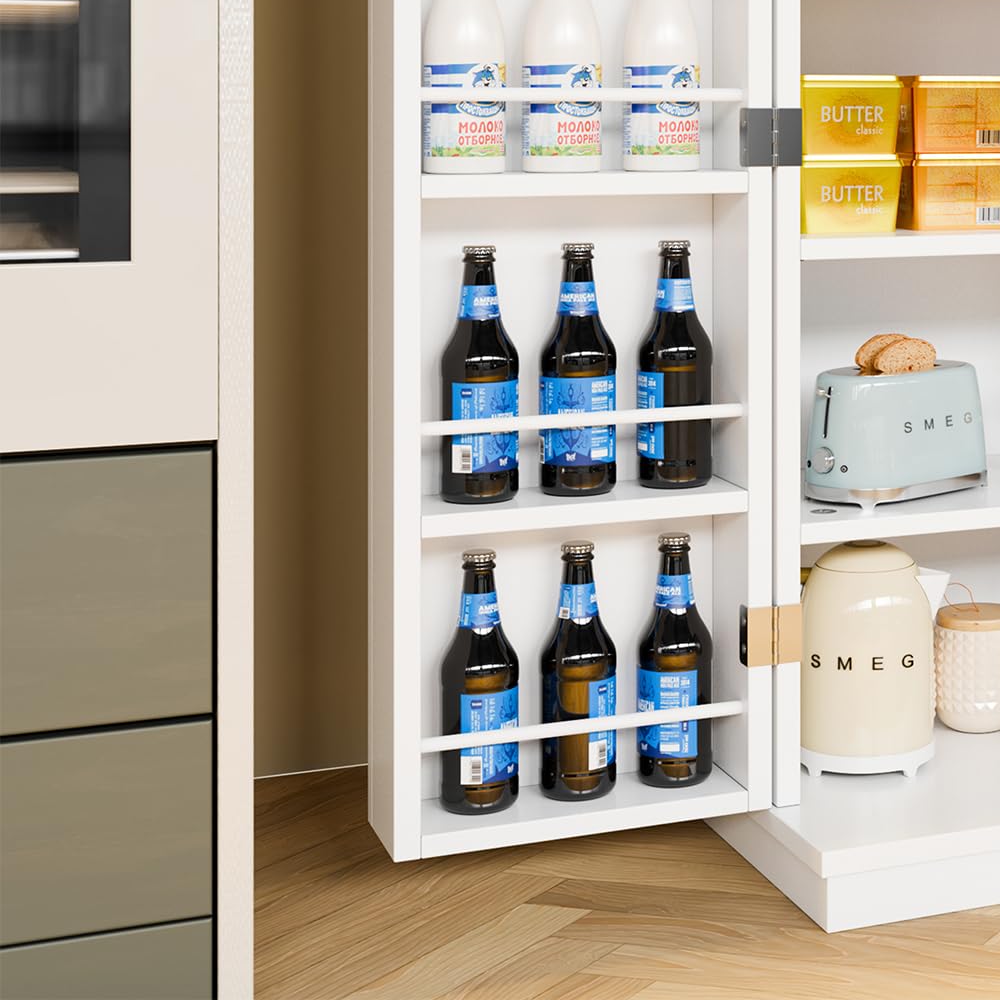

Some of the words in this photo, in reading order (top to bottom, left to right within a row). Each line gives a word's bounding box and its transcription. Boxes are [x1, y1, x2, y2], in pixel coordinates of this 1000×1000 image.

[820, 105, 884, 123] BUTTER
[856, 124, 884, 135] classic
[820, 185, 884, 203] BUTTER
[856, 204, 884, 215] classic
[903, 411, 973, 434] SMEG
[810, 653, 915, 671] SMEG
